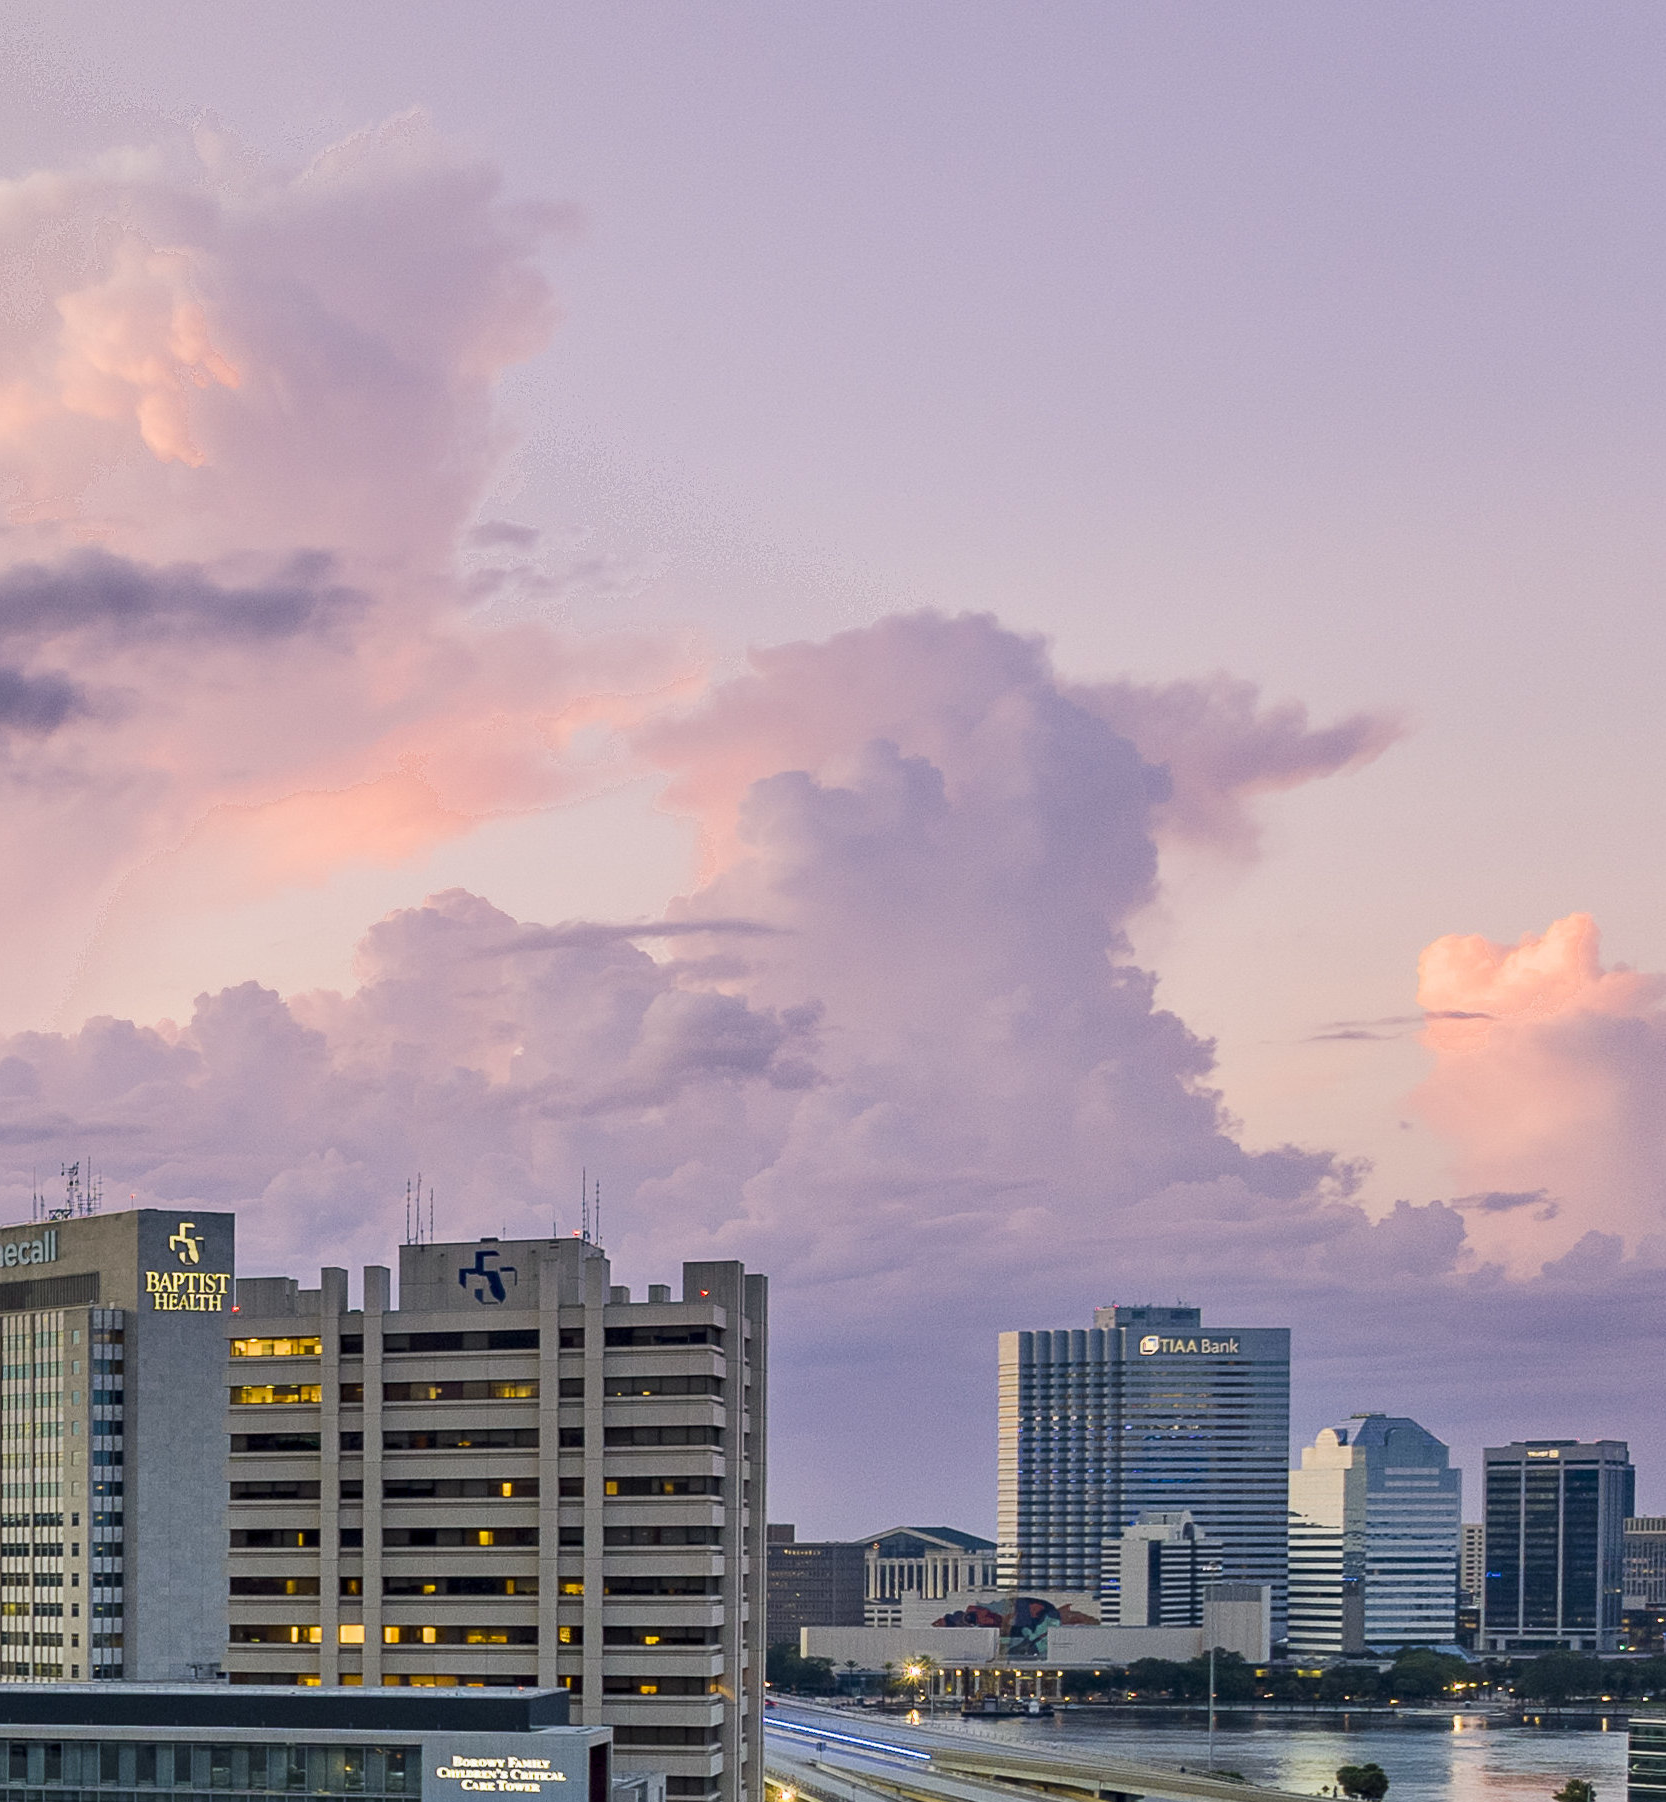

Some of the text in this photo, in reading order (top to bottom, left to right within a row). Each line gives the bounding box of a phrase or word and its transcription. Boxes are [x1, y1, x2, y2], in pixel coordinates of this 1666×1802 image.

[145, 1271, 230, 1294] BAPTIST
[154, 1293, 222, 1312] HEALTH
[1160, 1338, 1240, 1354] TIAA Bank
[508, 1756, 550, 1769] FAMILY
[509, 1769, 567, 1781] CRITICAL
[461, 1779, 541, 1793] CARE TOWER
